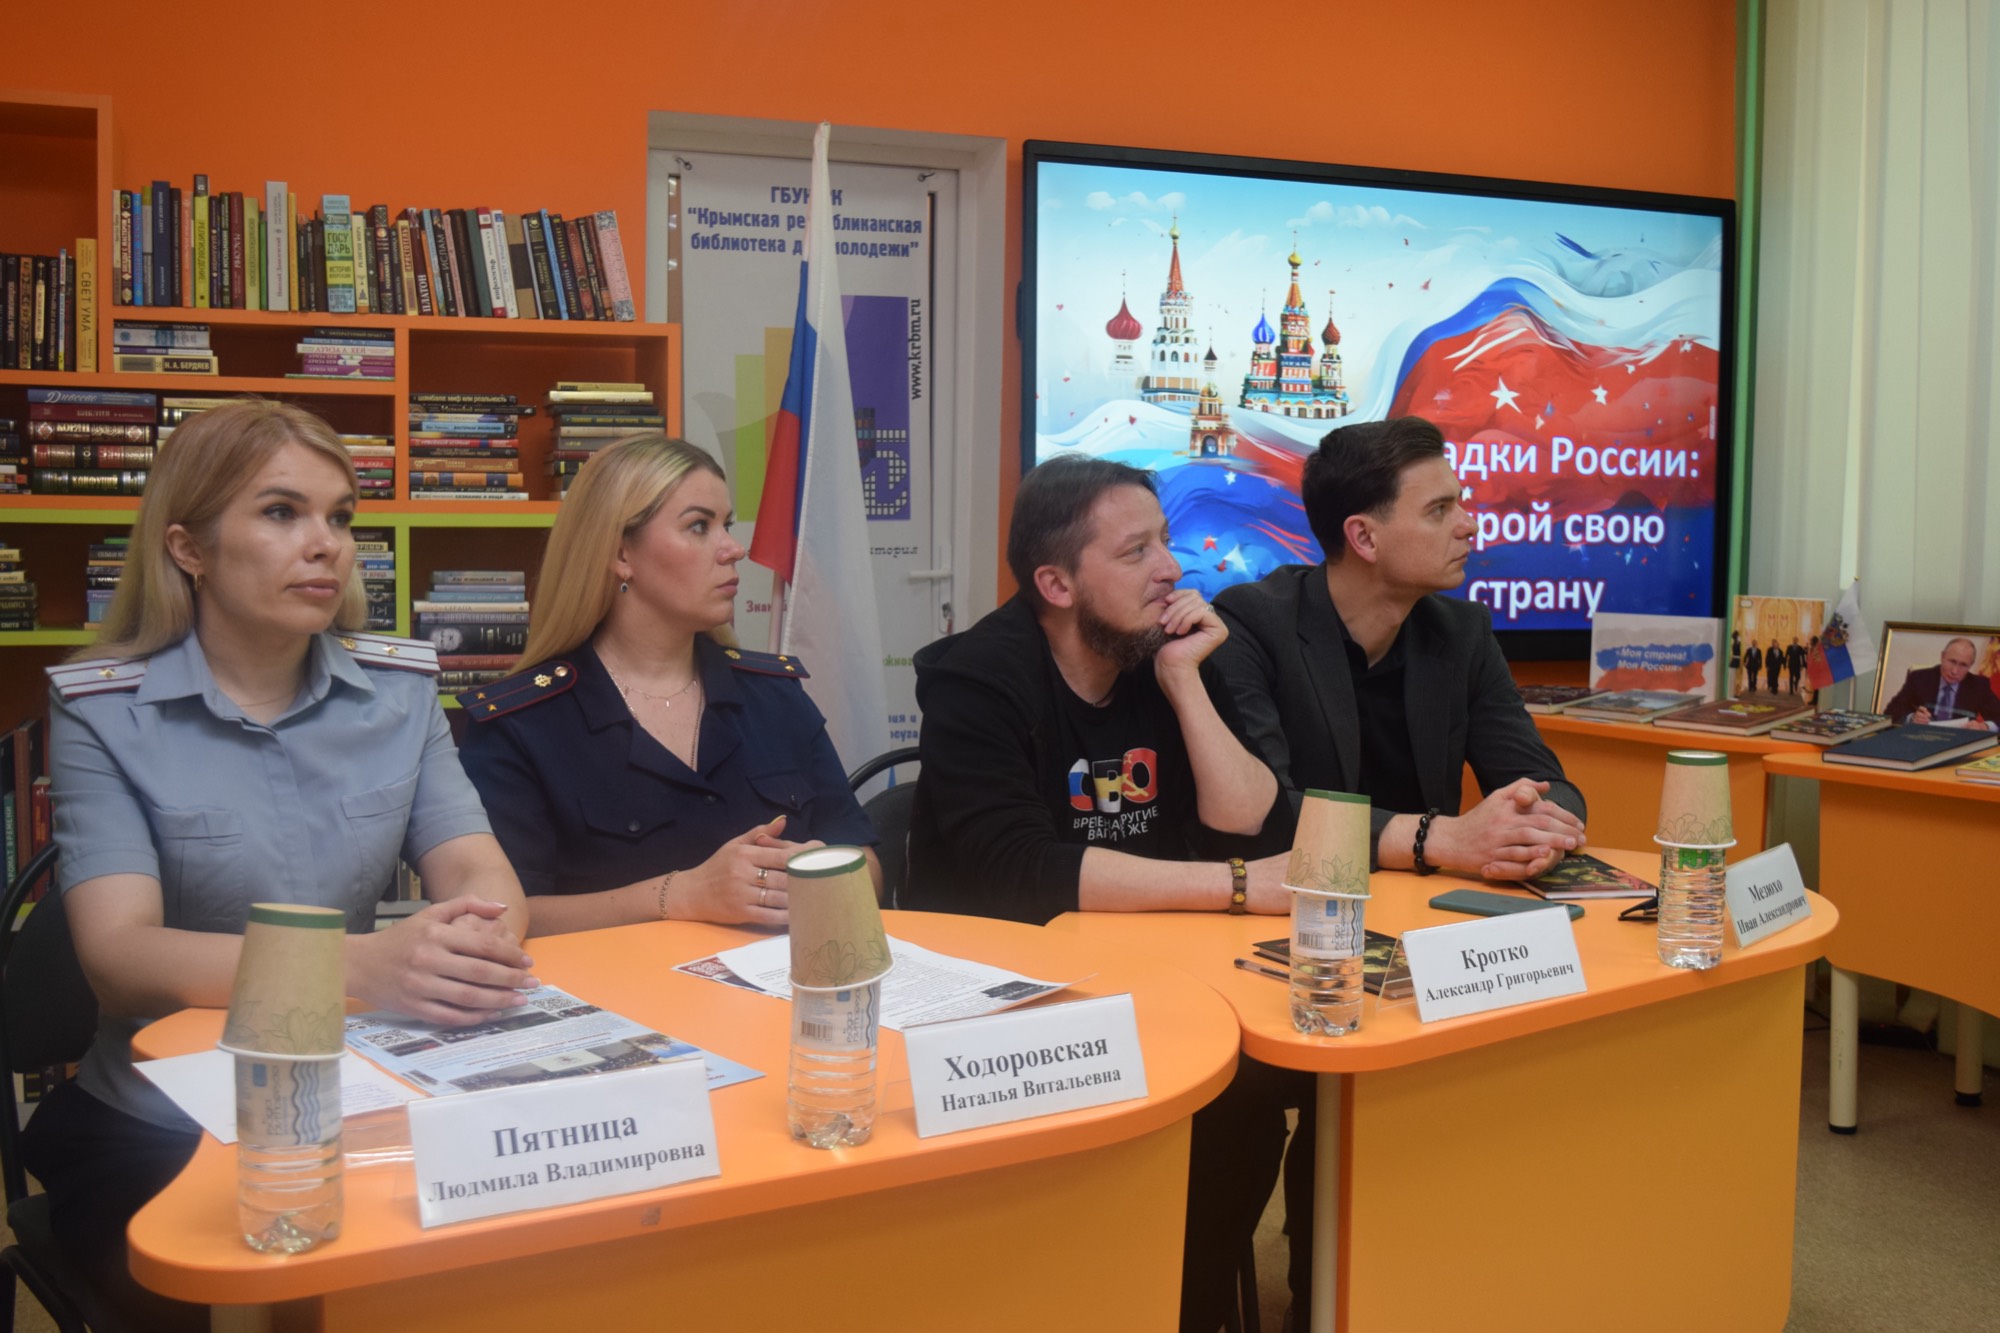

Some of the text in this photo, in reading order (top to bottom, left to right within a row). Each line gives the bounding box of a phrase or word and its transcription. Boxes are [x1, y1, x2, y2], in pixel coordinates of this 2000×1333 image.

[688, 206, 922, 234] “Крымская ребликанская
[402, 227, 411, 270] АРИСТОТЕЛЬ
[438, 234, 449, 270] ИСЛАМ
[691, 233, 786, 253] библиотека
[835, 241, 919, 258] олодежи”
[81, 271, 91, 303] СВЕТ
[418, 274, 431, 312] ПЛАТОН
[81, 307, 91, 333] УМА
[908, 298, 921, 400] www.krbm.ru
[1443, 436, 1699, 481] адки России:
[1563, 513, 1665, 544] свою
[1468, 579, 1605, 619] страну
[1616, 659, 1638, 670] Моя
[1644, 649, 1688, 662] страна!
[1067, 747, 1158, 813] СВО
[6, 806, 15, 845] ВРЕМЕНИ
[1748, 878, 1784, 904] Мезюхо
[1737, 894, 1806, 935] Иван Александрович
[1460, 943, 1530, 972] Кротко
[1425, 962, 1575, 1003] Александр Григорьевич
[943, 1036, 1109, 1083] Ходоровская
[940, 1068, 1122, 1113] Наталья Витальевна
[492, 1113, 639, 1158] Пятница
[427, 1142, 706, 1203] Людмила Владимировна
